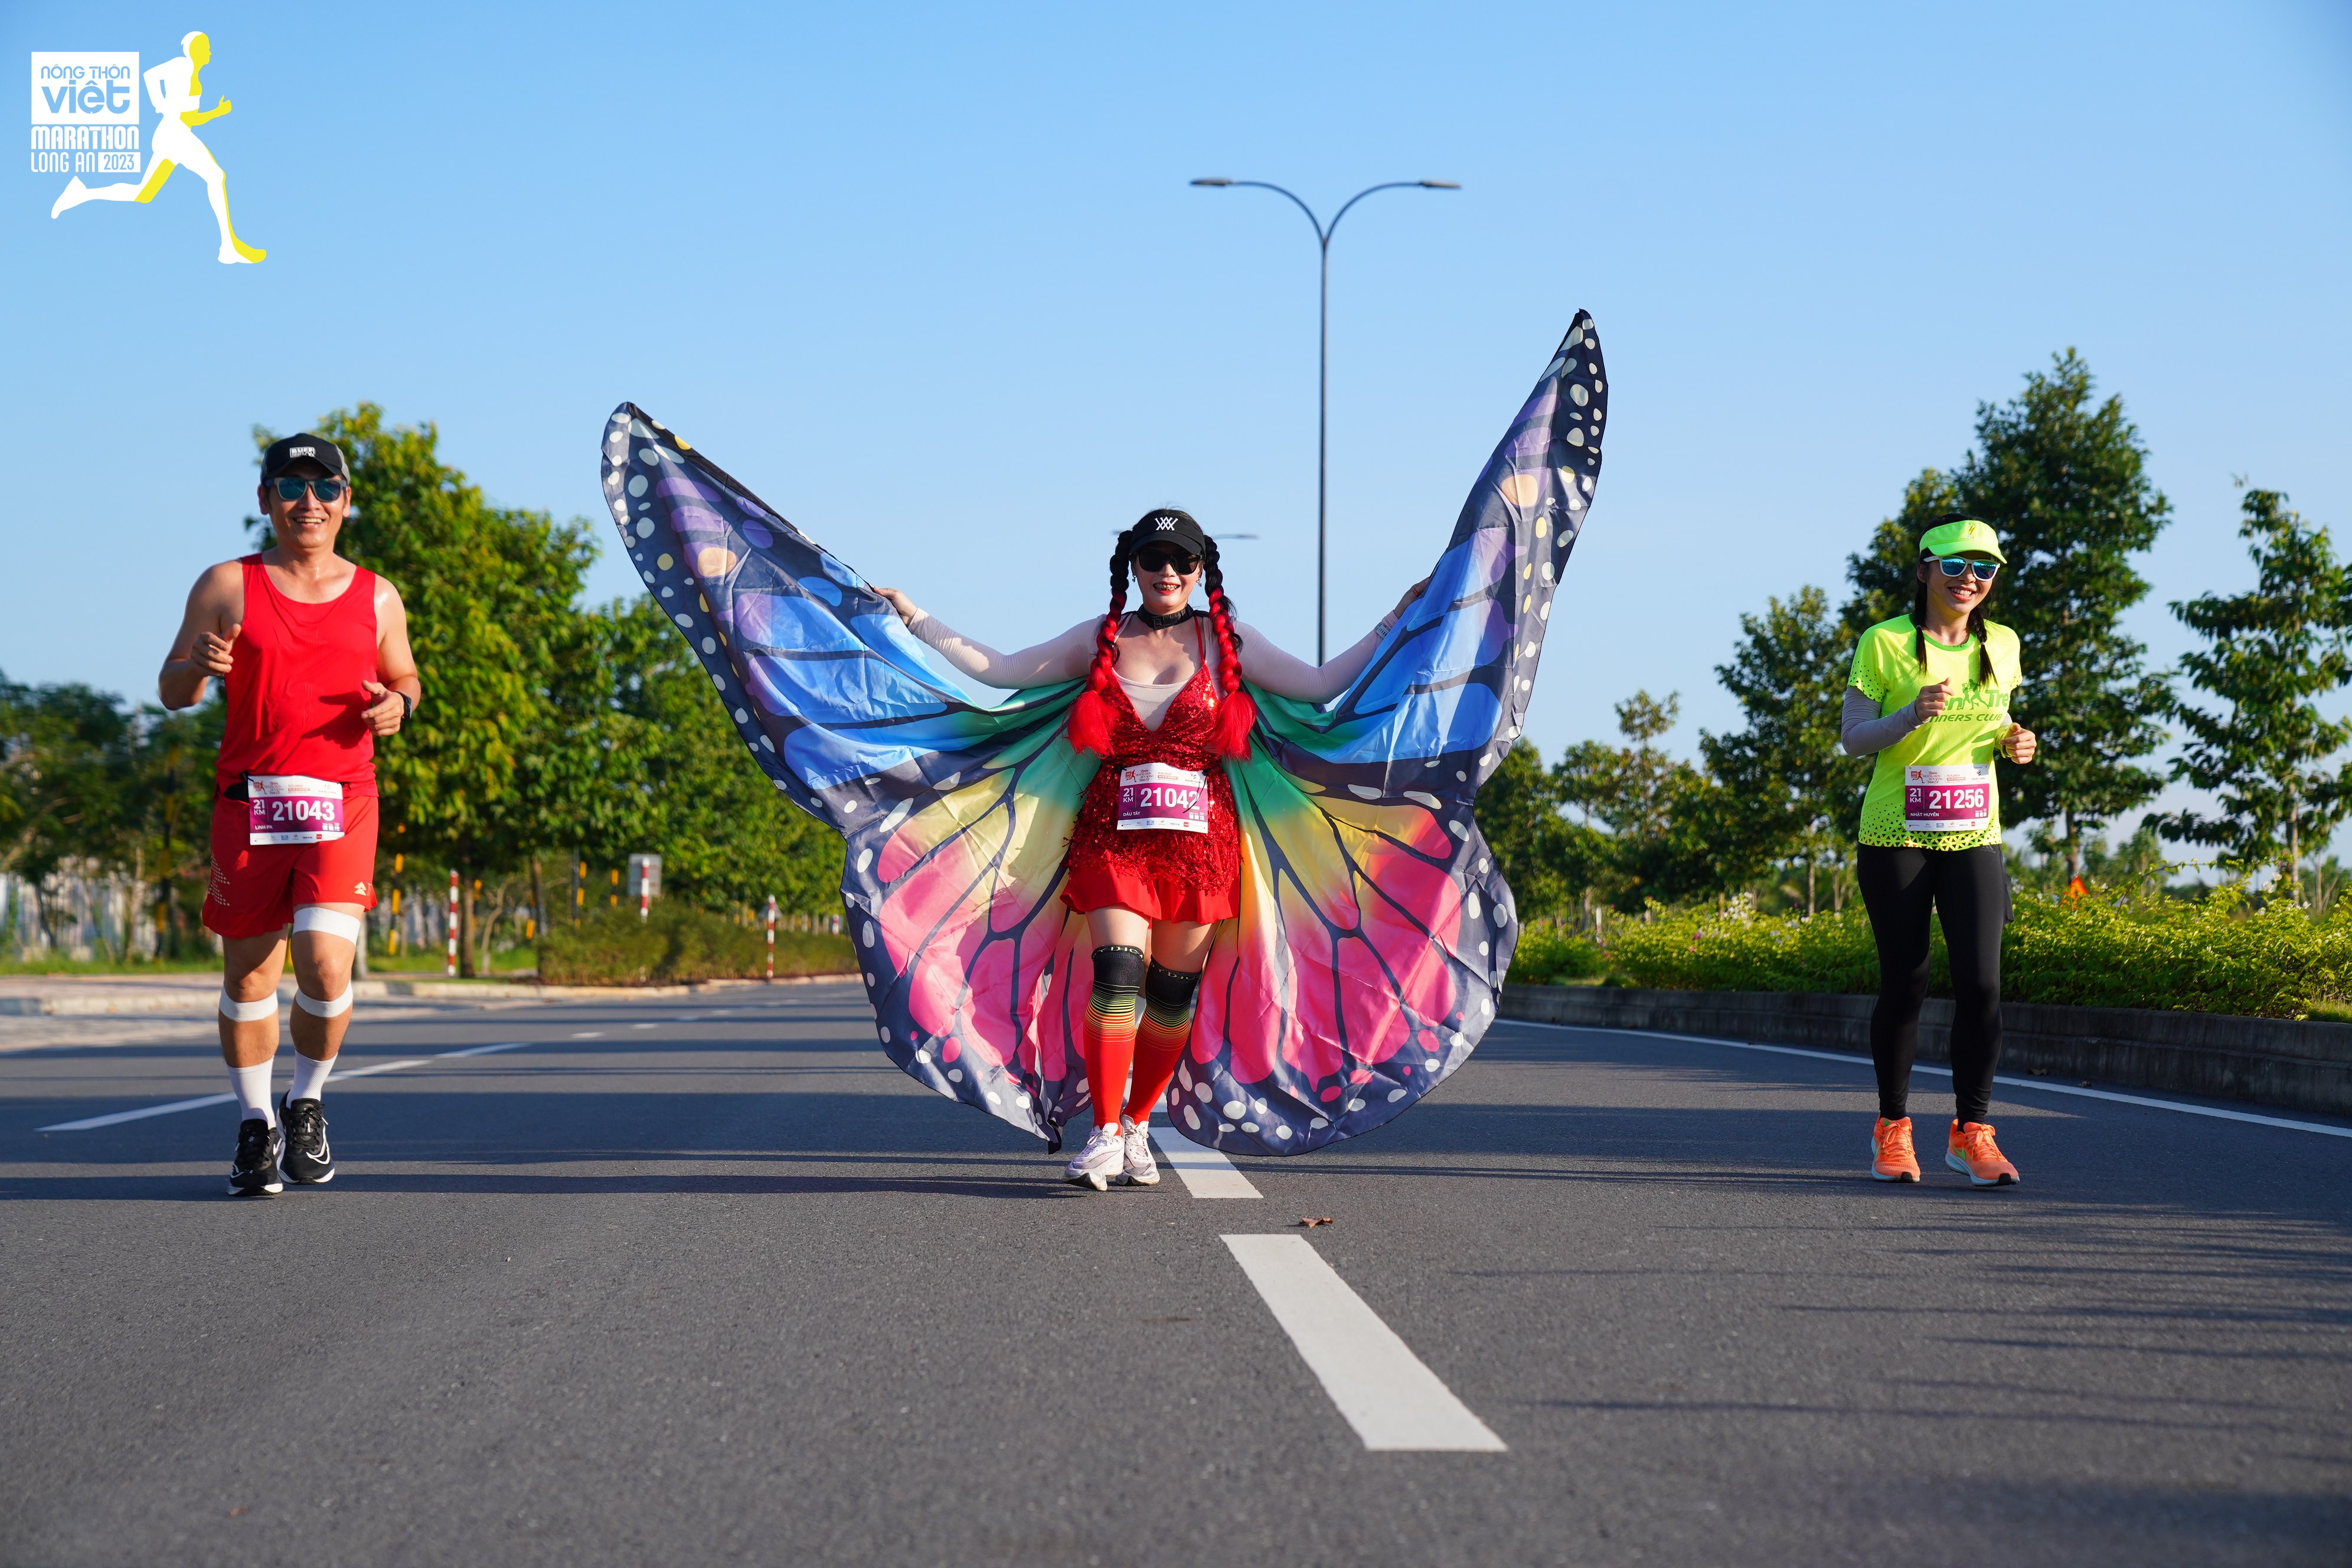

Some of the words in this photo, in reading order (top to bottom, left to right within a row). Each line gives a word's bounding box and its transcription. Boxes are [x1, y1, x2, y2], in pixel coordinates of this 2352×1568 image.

[1985, 690, 2009, 707] Tre
[1123, 788, 1133, 797] 21
[1141, 788, 1200, 810] 21042
[1909, 788, 1921, 797] 21
[1929, 788, 1984, 809] 21256
[253, 799, 264, 809] 21
[272, 800, 335, 821] 21043
